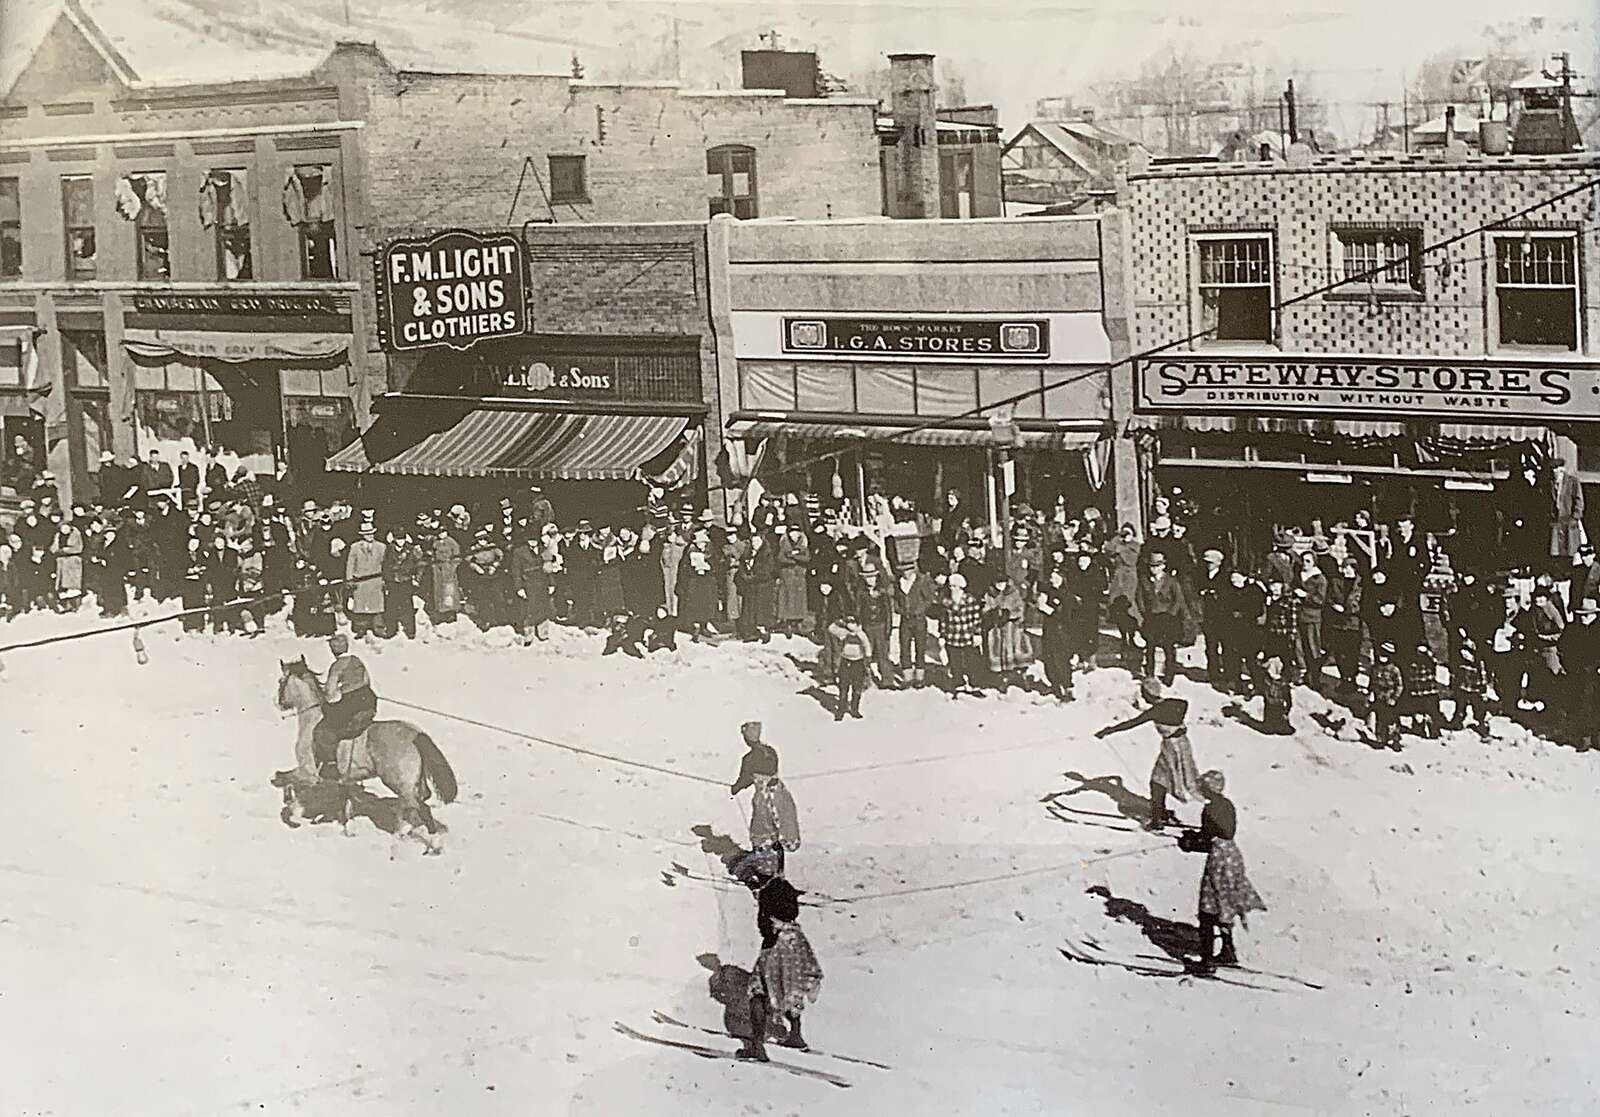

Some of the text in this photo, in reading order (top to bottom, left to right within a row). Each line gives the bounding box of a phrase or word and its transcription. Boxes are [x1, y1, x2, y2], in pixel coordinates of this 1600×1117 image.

[390, 246, 516, 284] F.M.LIGHT
[413, 280, 505, 317] & SONS
[403, 311, 516, 343] CLOTHIERS
[917, 324, 963, 334] MARKET
[899, 336, 993, 352] STORES
[559, 374, 569, 388] &
[570, 366, 611, 389] Sons
[1159, 363, 1571, 406] SAFEWAY-STORES
[1206, 390, 1510, 409] DISTRIBUTION WITHOUT WASTE
